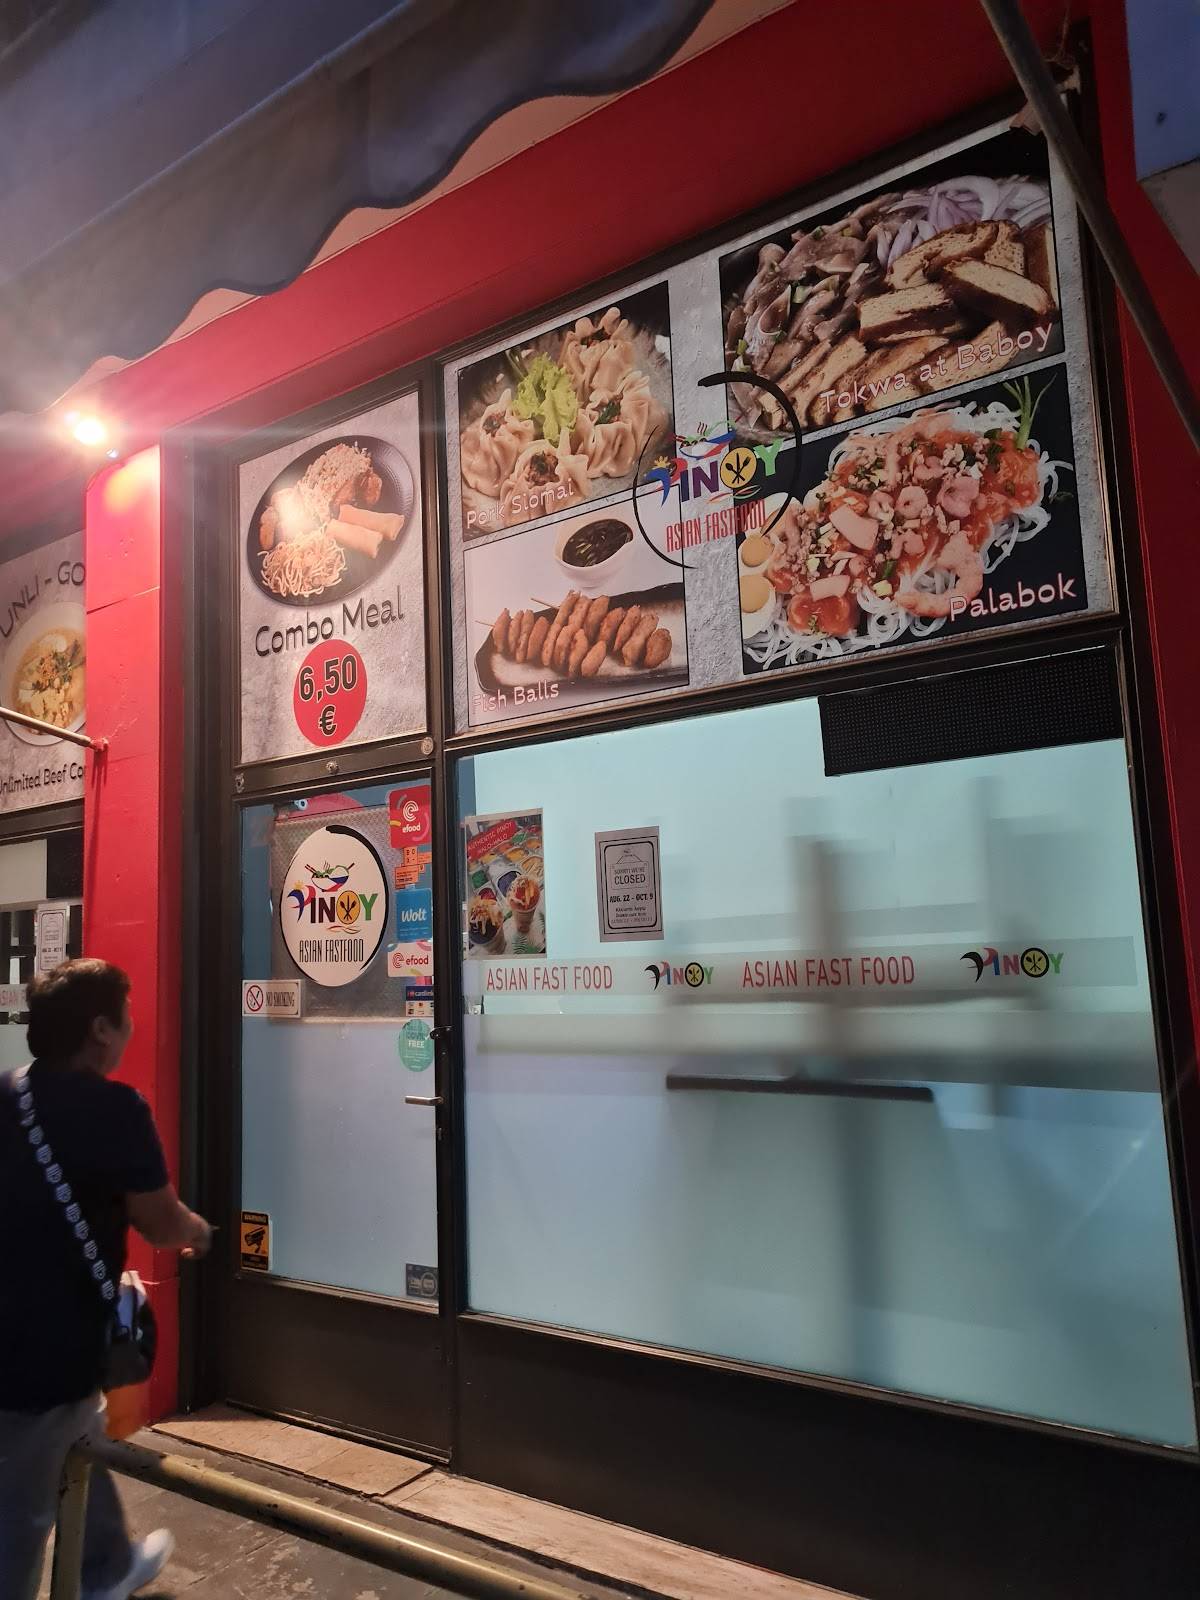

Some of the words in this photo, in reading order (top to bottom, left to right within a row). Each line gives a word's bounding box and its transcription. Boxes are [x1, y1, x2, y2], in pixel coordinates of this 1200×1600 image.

[820, 373, 910, 413] Tokwa
[920, 355, 947, 382] at
[957, 322, 1053, 371] Baboy
[645, 437, 785, 508] PINOY
[466, 504, 505, 529] Pork
[511, 477, 576, 514] Siomai
[666, 515, 701, 553] ASIAN
[705, 499, 767, 544] FASTFOOD
[0, 574, 40, 638] UNLI
[950, 572, 1077, 622] Palabok
[255, 610, 334, 657] Combo
[343, 585, 404, 635] Meal
[299, 654, 357, 703] 6,50
[472, 688, 507, 713] Fish
[514, 680, 559, 705] Balls
[318, 704, 337, 736] €
[44, 763, 67, 785] Beef
[402, 824, 421, 833] efood
[614, 874, 646, 885] CLOSED
[287, 884, 379, 924] PINOY
[623, 894, 630, 902] 22
[401, 908, 427, 922] Wolt
[299, 939, 323, 963] ASIAN
[325, 938, 364, 963] FASTFOOD
[405, 955, 429, 966] efood
[486, 967, 528, 991] ASIAN
[533, 966, 568, 991] FAST
[574, 965, 613, 990] FOOD
[644, 960, 714, 991] PINOY
[742, 960, 798, 988] ASIAN
[805, 958, 852, 987] FAST
[860, 955, 915, 985] FOOD
[960, 947, 1064, 983] PINOY
[266, 992, 272, 1007] NO
[408, 1040, 425, 1048] FREE
